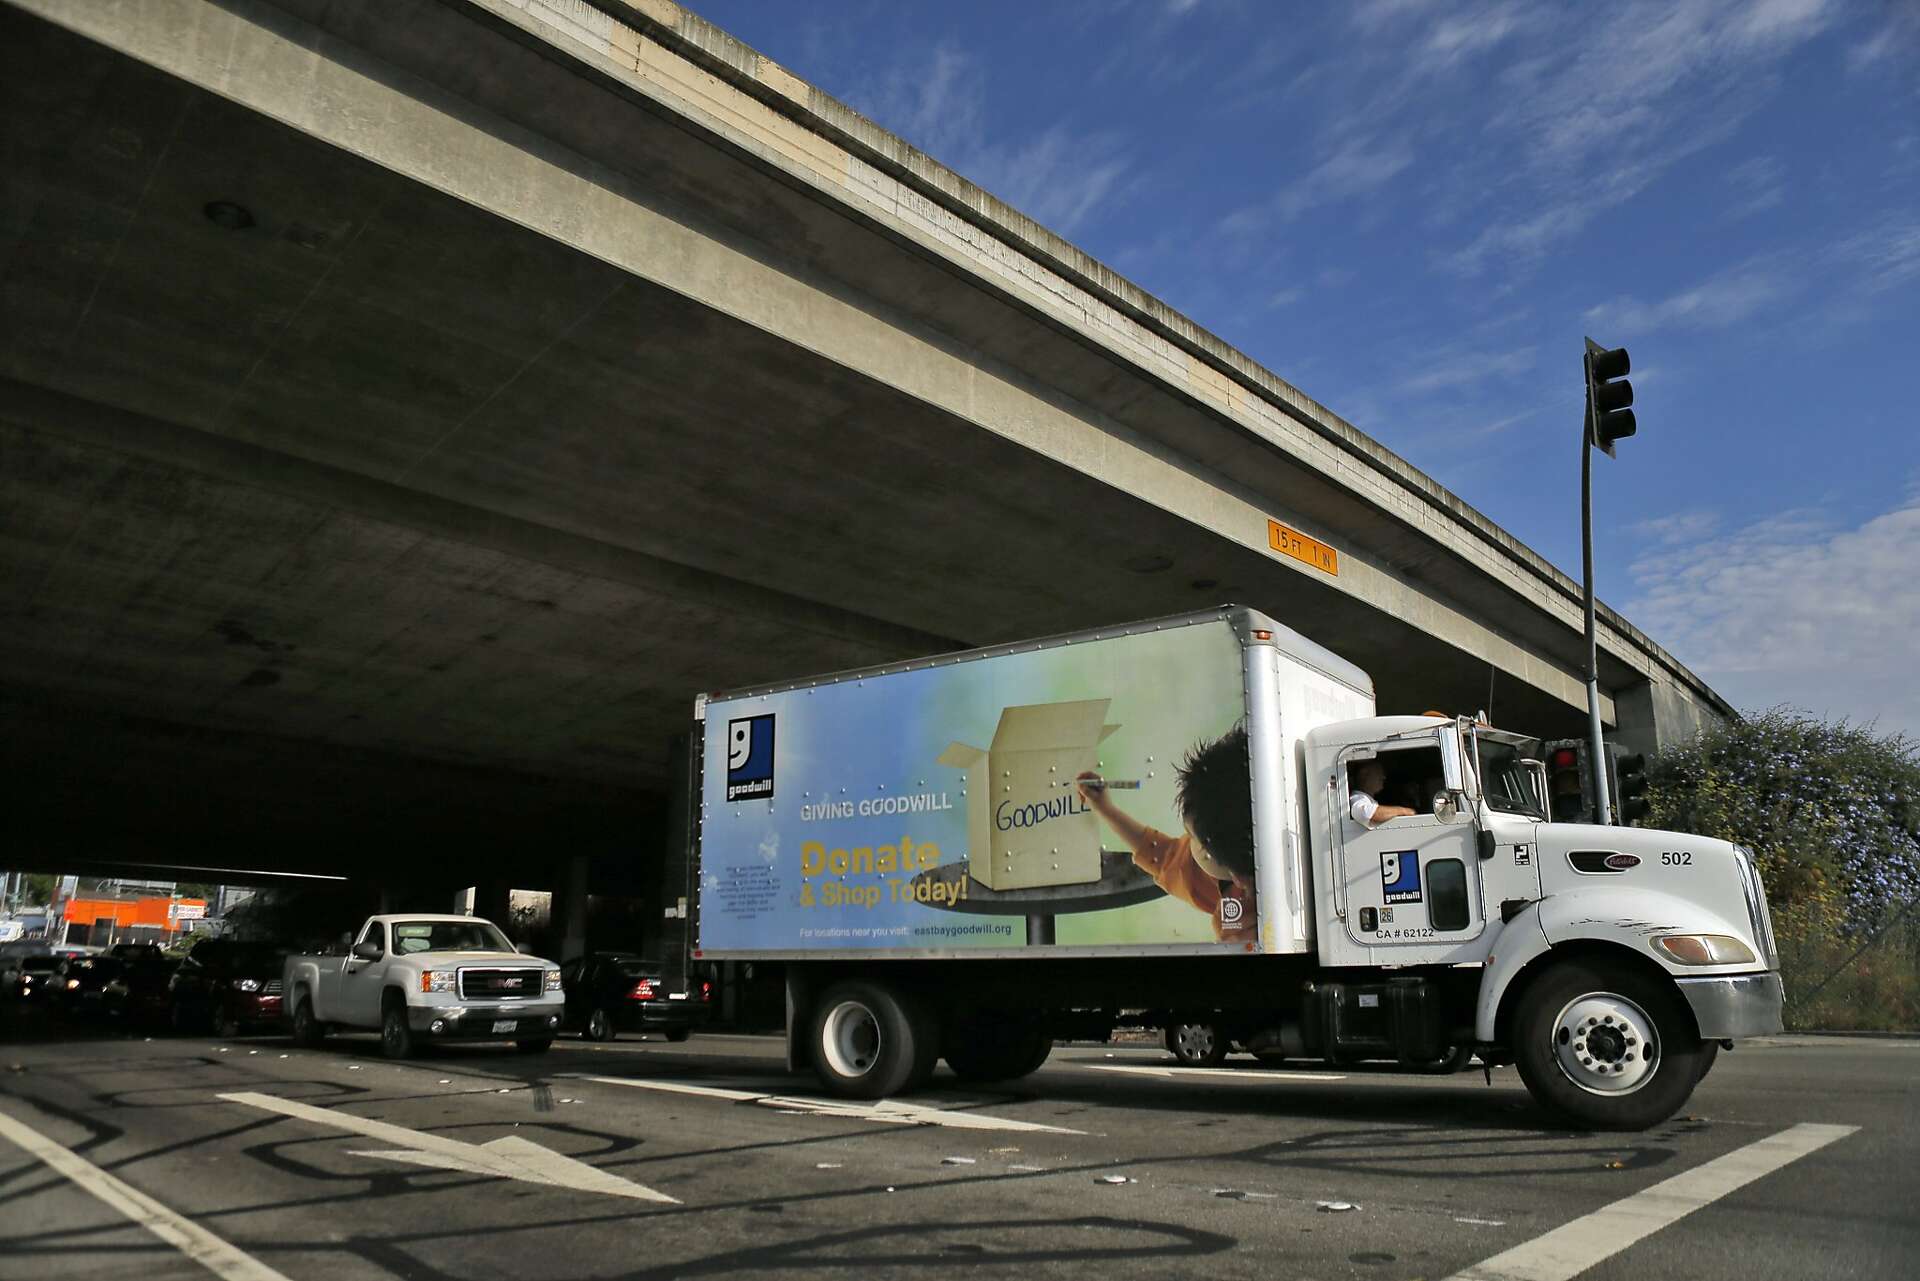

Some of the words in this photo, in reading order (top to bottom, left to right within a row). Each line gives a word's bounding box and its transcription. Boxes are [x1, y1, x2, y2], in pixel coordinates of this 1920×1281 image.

[1276, 528, 1288, 549] 15
[1292, 539, 1301, 555] FT
[729, 779, 771, 799] goodwill
[801, 800, 854, 821] GIVING
[859, 792, 952, 816] GOODWILL
[801, 836, 940, 876] Donate
[1661, 851, 1692, 866] 502
[800, 883, 815, 907] &
[821, 879, 881, 910] Shop
[889, 874, 968, 906] Today!
[1385, 891, 1420, 903] goodwill
[800, 928, 814, 937] For
[815, 926, 850, 937] locations
[852, 926, 872, 937] near
[872, 926, 889, 939] you
[914, 923, 1012, 937] eastbaygoodwill.org
[1376, 930, 1391, 938] CA
[1394, 929, 1401, 938] #
[1403, 928, 1434, 938] 62122
